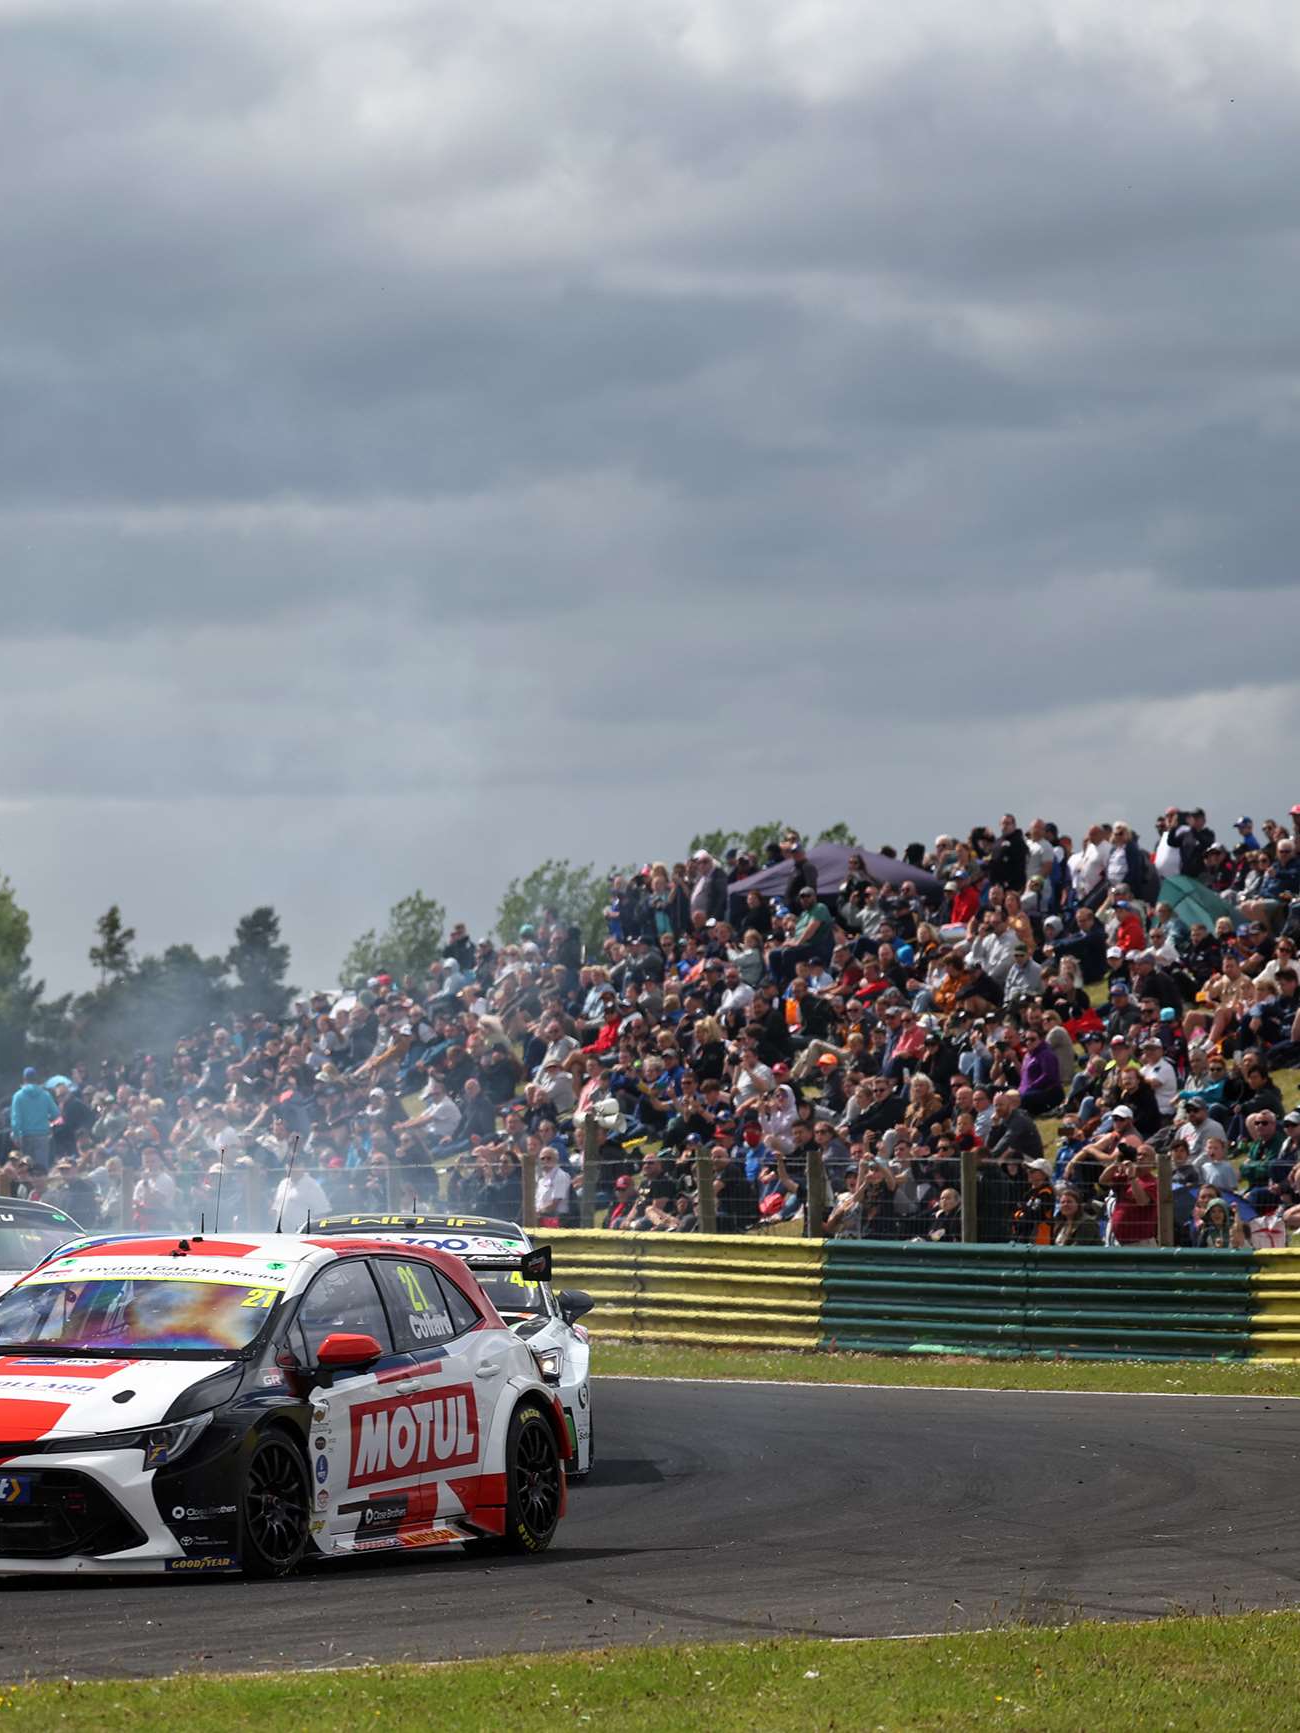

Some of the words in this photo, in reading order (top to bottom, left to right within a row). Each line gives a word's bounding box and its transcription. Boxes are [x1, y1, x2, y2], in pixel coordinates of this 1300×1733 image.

[79, 1264, 148, 1273] TOYOTA
[222, 1268, 286, 1282] Racing
[240, 1288, 279, 1309] 21
[396, 1265, 429, 1312] 21
[408, 1309, 454, 1340] Collard
[262, 1376, 282, 1386] GR
[353, 1395, 475, 1477] MOTUL
[171, 1556, 232, 1570] GOODYEAR
